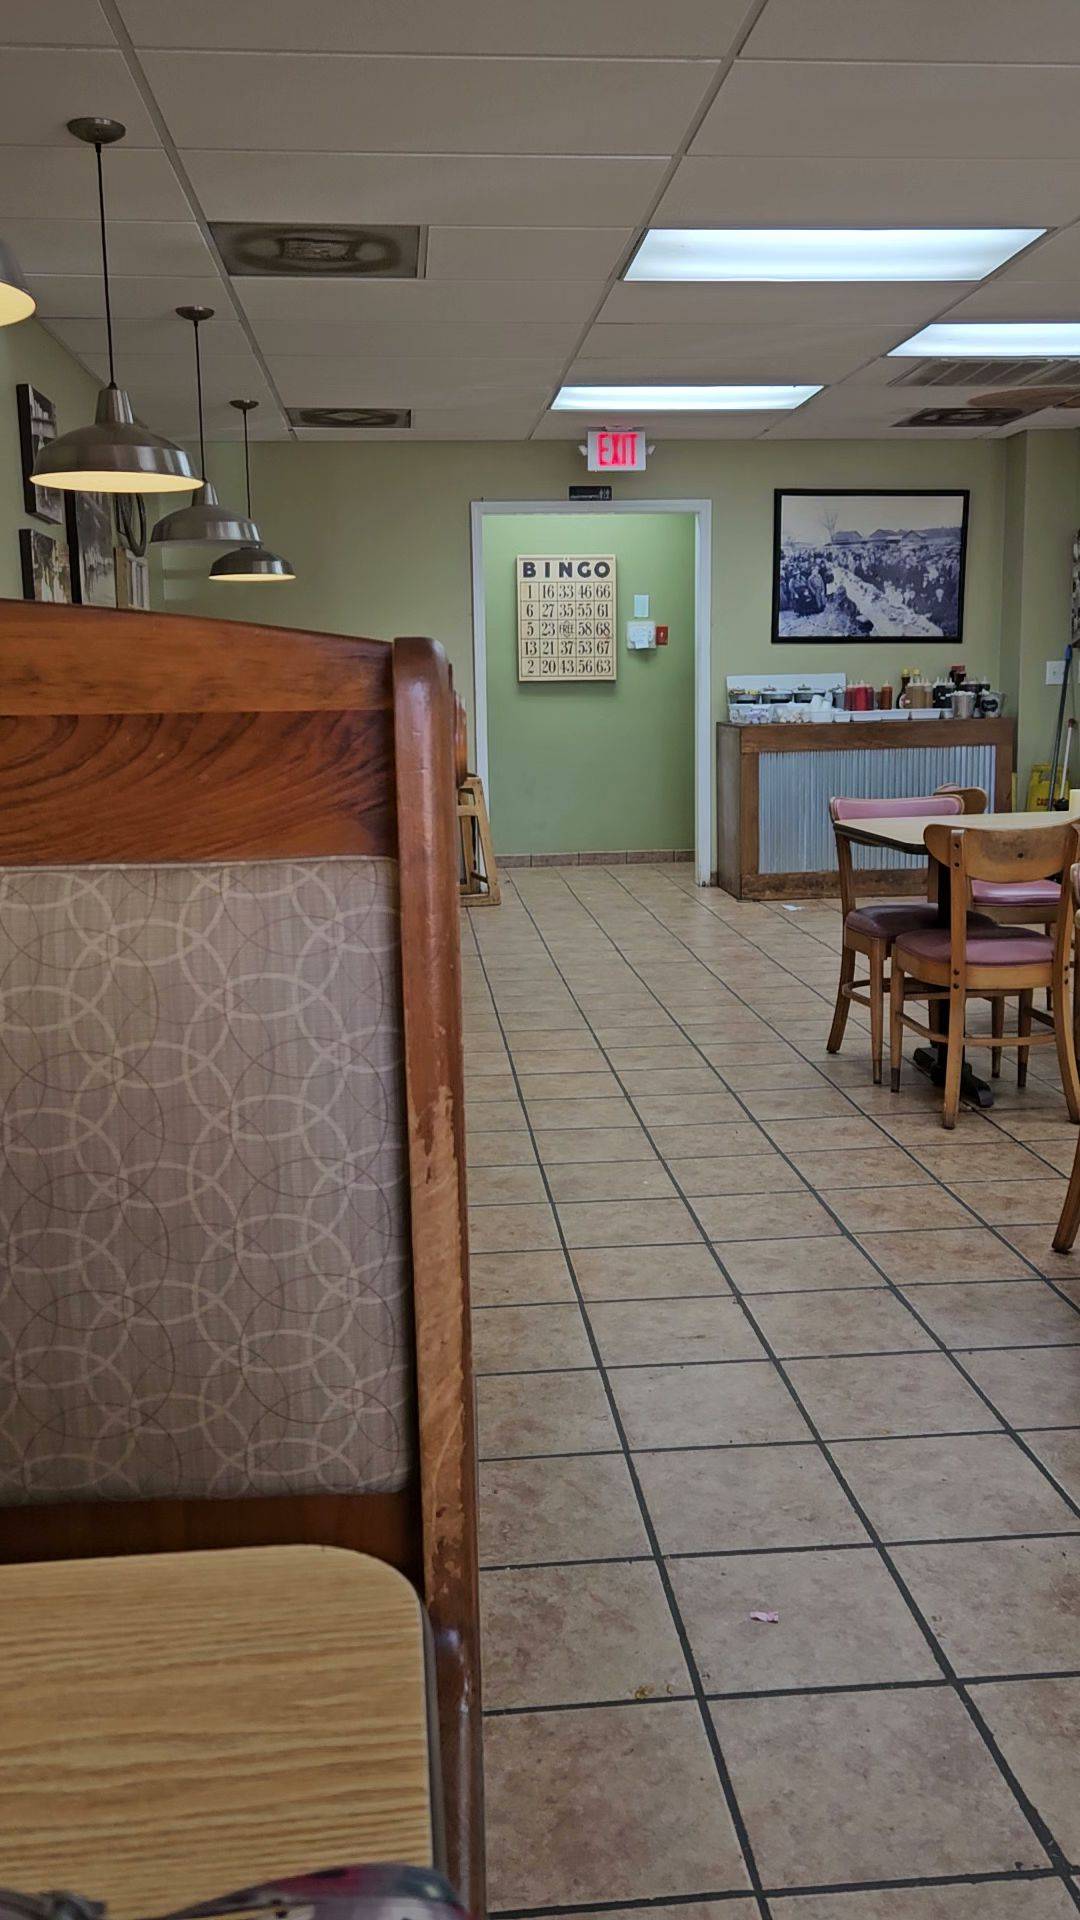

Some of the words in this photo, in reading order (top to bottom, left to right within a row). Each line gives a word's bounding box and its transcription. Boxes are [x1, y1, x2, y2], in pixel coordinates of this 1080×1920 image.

[598, 433, 638, 466] EXIT
[522, 561, 611, 579] BINGO
[528, 584, 532, 599] 1
[542, 584, 555, 599] 16
[559, 584, 574, 599] 33
[578, 584, 592, 599] 46
[596, 584, 611, 599] 66
[526, 603, 534, 618] 6
[542, 603, 555, 618] 27
[559, 603, 574, 618] 35
[578, 603, 592, 618] 55
[597, 603, 609, 618] 61
[527, 622, 534, 636] 5
[541, 622, 555, 636] 23
[559, 624, 574, 634] FREE
[578, 622, 592, 636] 58
[596, 622, 611, 636] 68
[525, 641, 537, 655] 13
[542, 641, 554, 655] 21
[561, 641, 574, 655] 37
[578, 641, 593, 655] 53
[596, 641, 610, 655] 67
[527, 659, 534, 674] 2
[542, 659, 556, 674] 20
[578, 659, 593, 674] 56
[596, 659, 611, 674] 63
